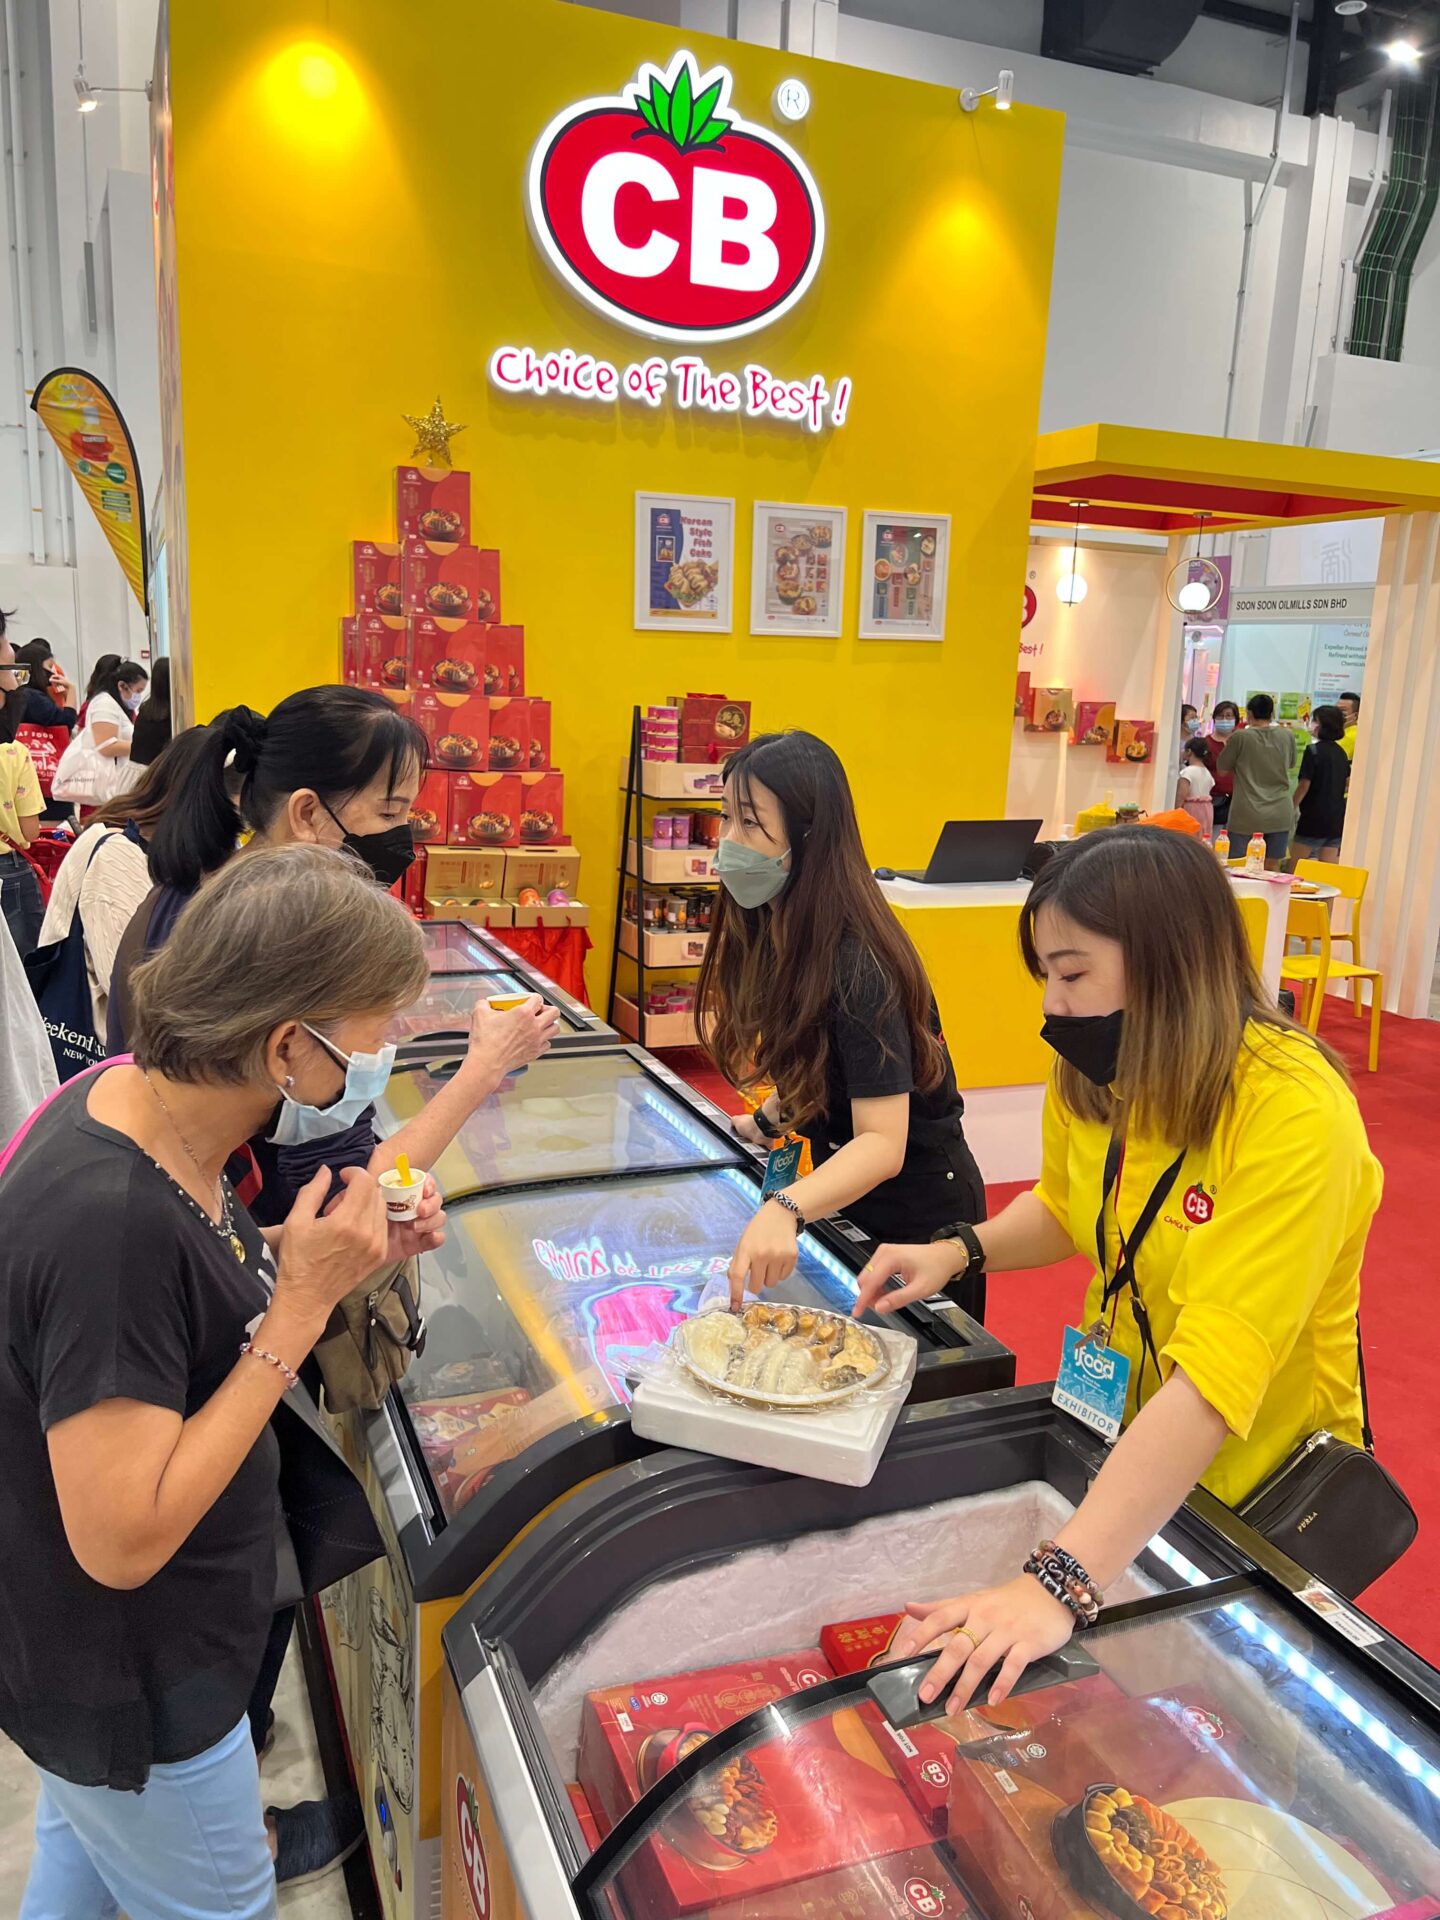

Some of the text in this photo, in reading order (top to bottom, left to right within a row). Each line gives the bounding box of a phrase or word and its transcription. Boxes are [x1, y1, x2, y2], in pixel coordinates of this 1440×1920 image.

[581, 151, 780, 292] CB
[496, 353, 614, 394] Choice
[629, 363, 663, 400] of
[675, 363, 736, 404] The
[1236, 598, 1347, 610] SOON SOON OILMILLS SDN BHD
[1186, 1193, 1208, 1219] CB
[1056, 1392, 1114, 1434] EXHIBITOR
[926, 1763, 946, 1783] CB
[460, 1801, 486, 1916] CB
[909, 1883, 937, 1913] CB
